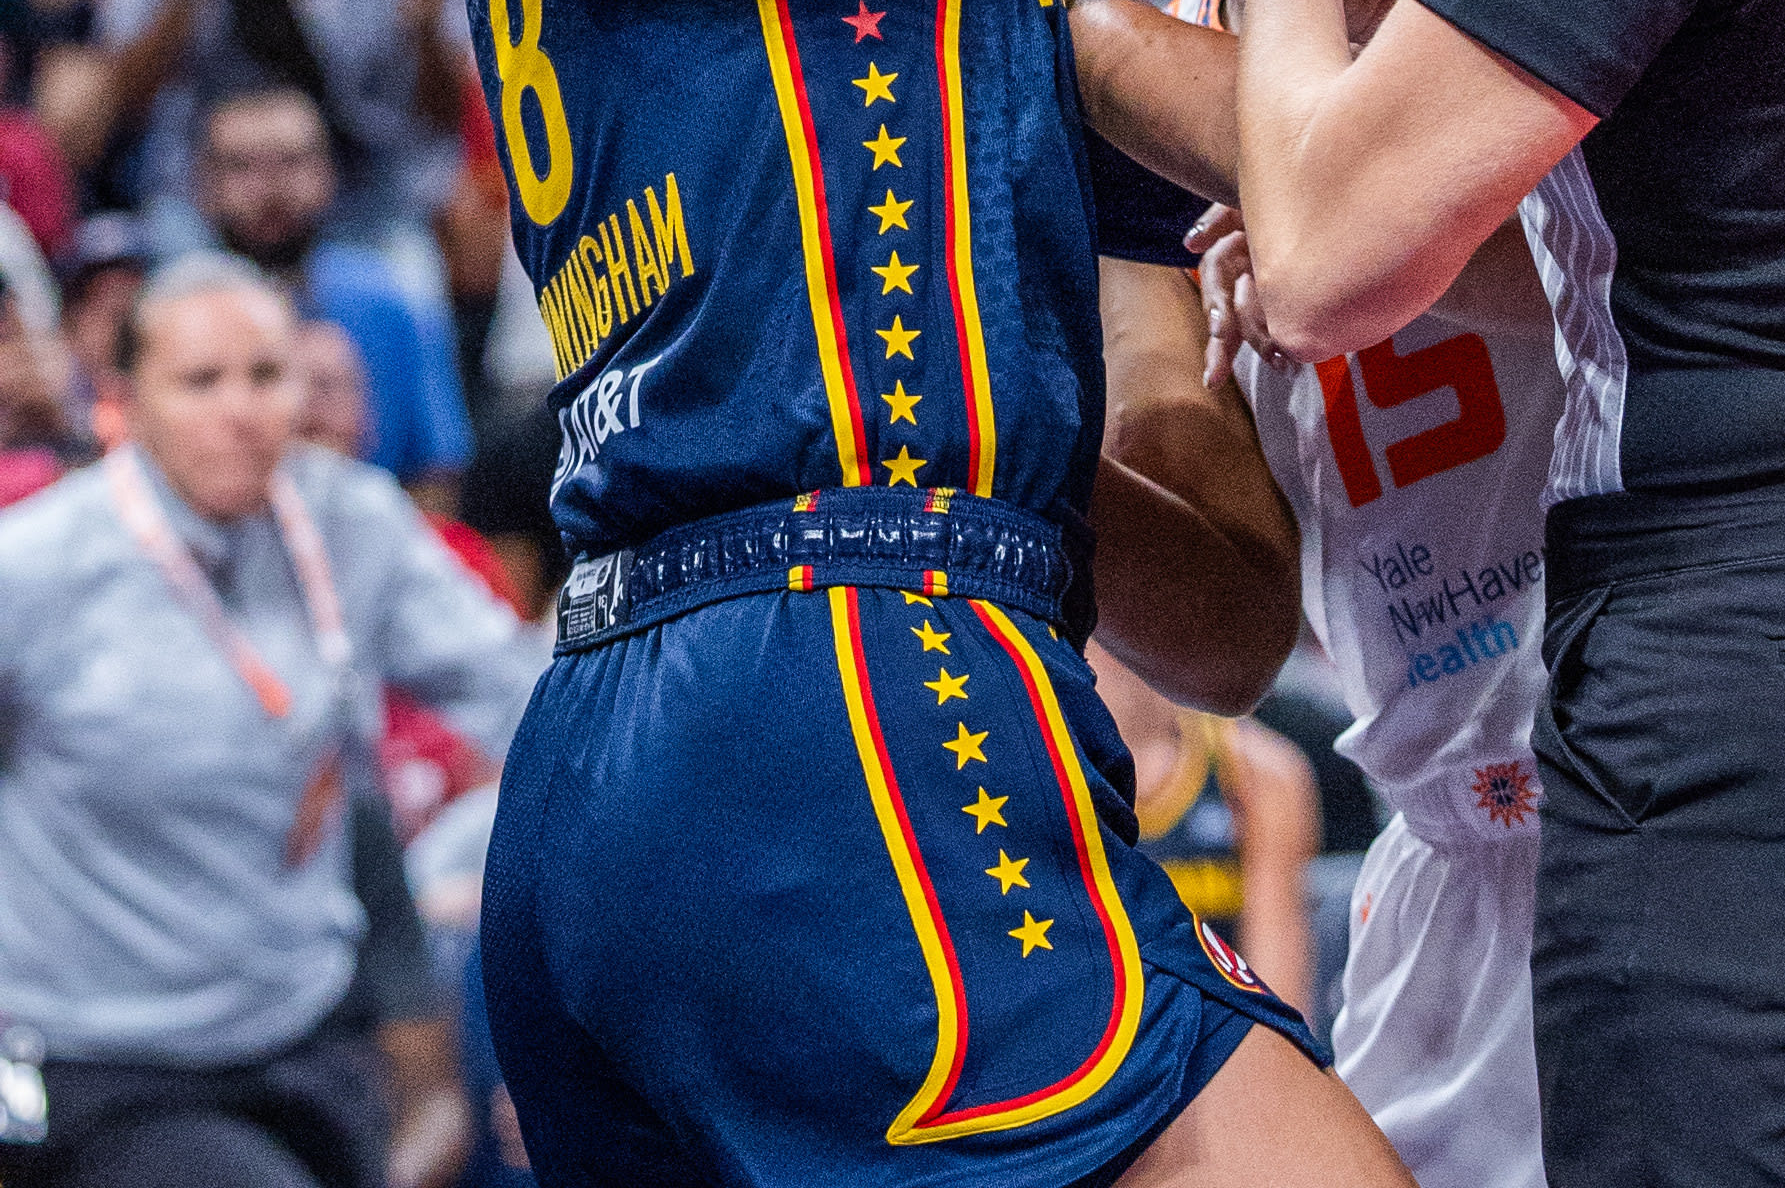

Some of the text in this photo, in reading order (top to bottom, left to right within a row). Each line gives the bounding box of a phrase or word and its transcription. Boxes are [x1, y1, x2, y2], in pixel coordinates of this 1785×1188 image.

[540, 172, 695, 384] NINGHAM
[571, 354, 663, 476] AT&T
[1314, 332, 1507, 509] 15
[1361, 542, 1434, 593] Yale
[1387, 548, 1547, 645] NwHave
